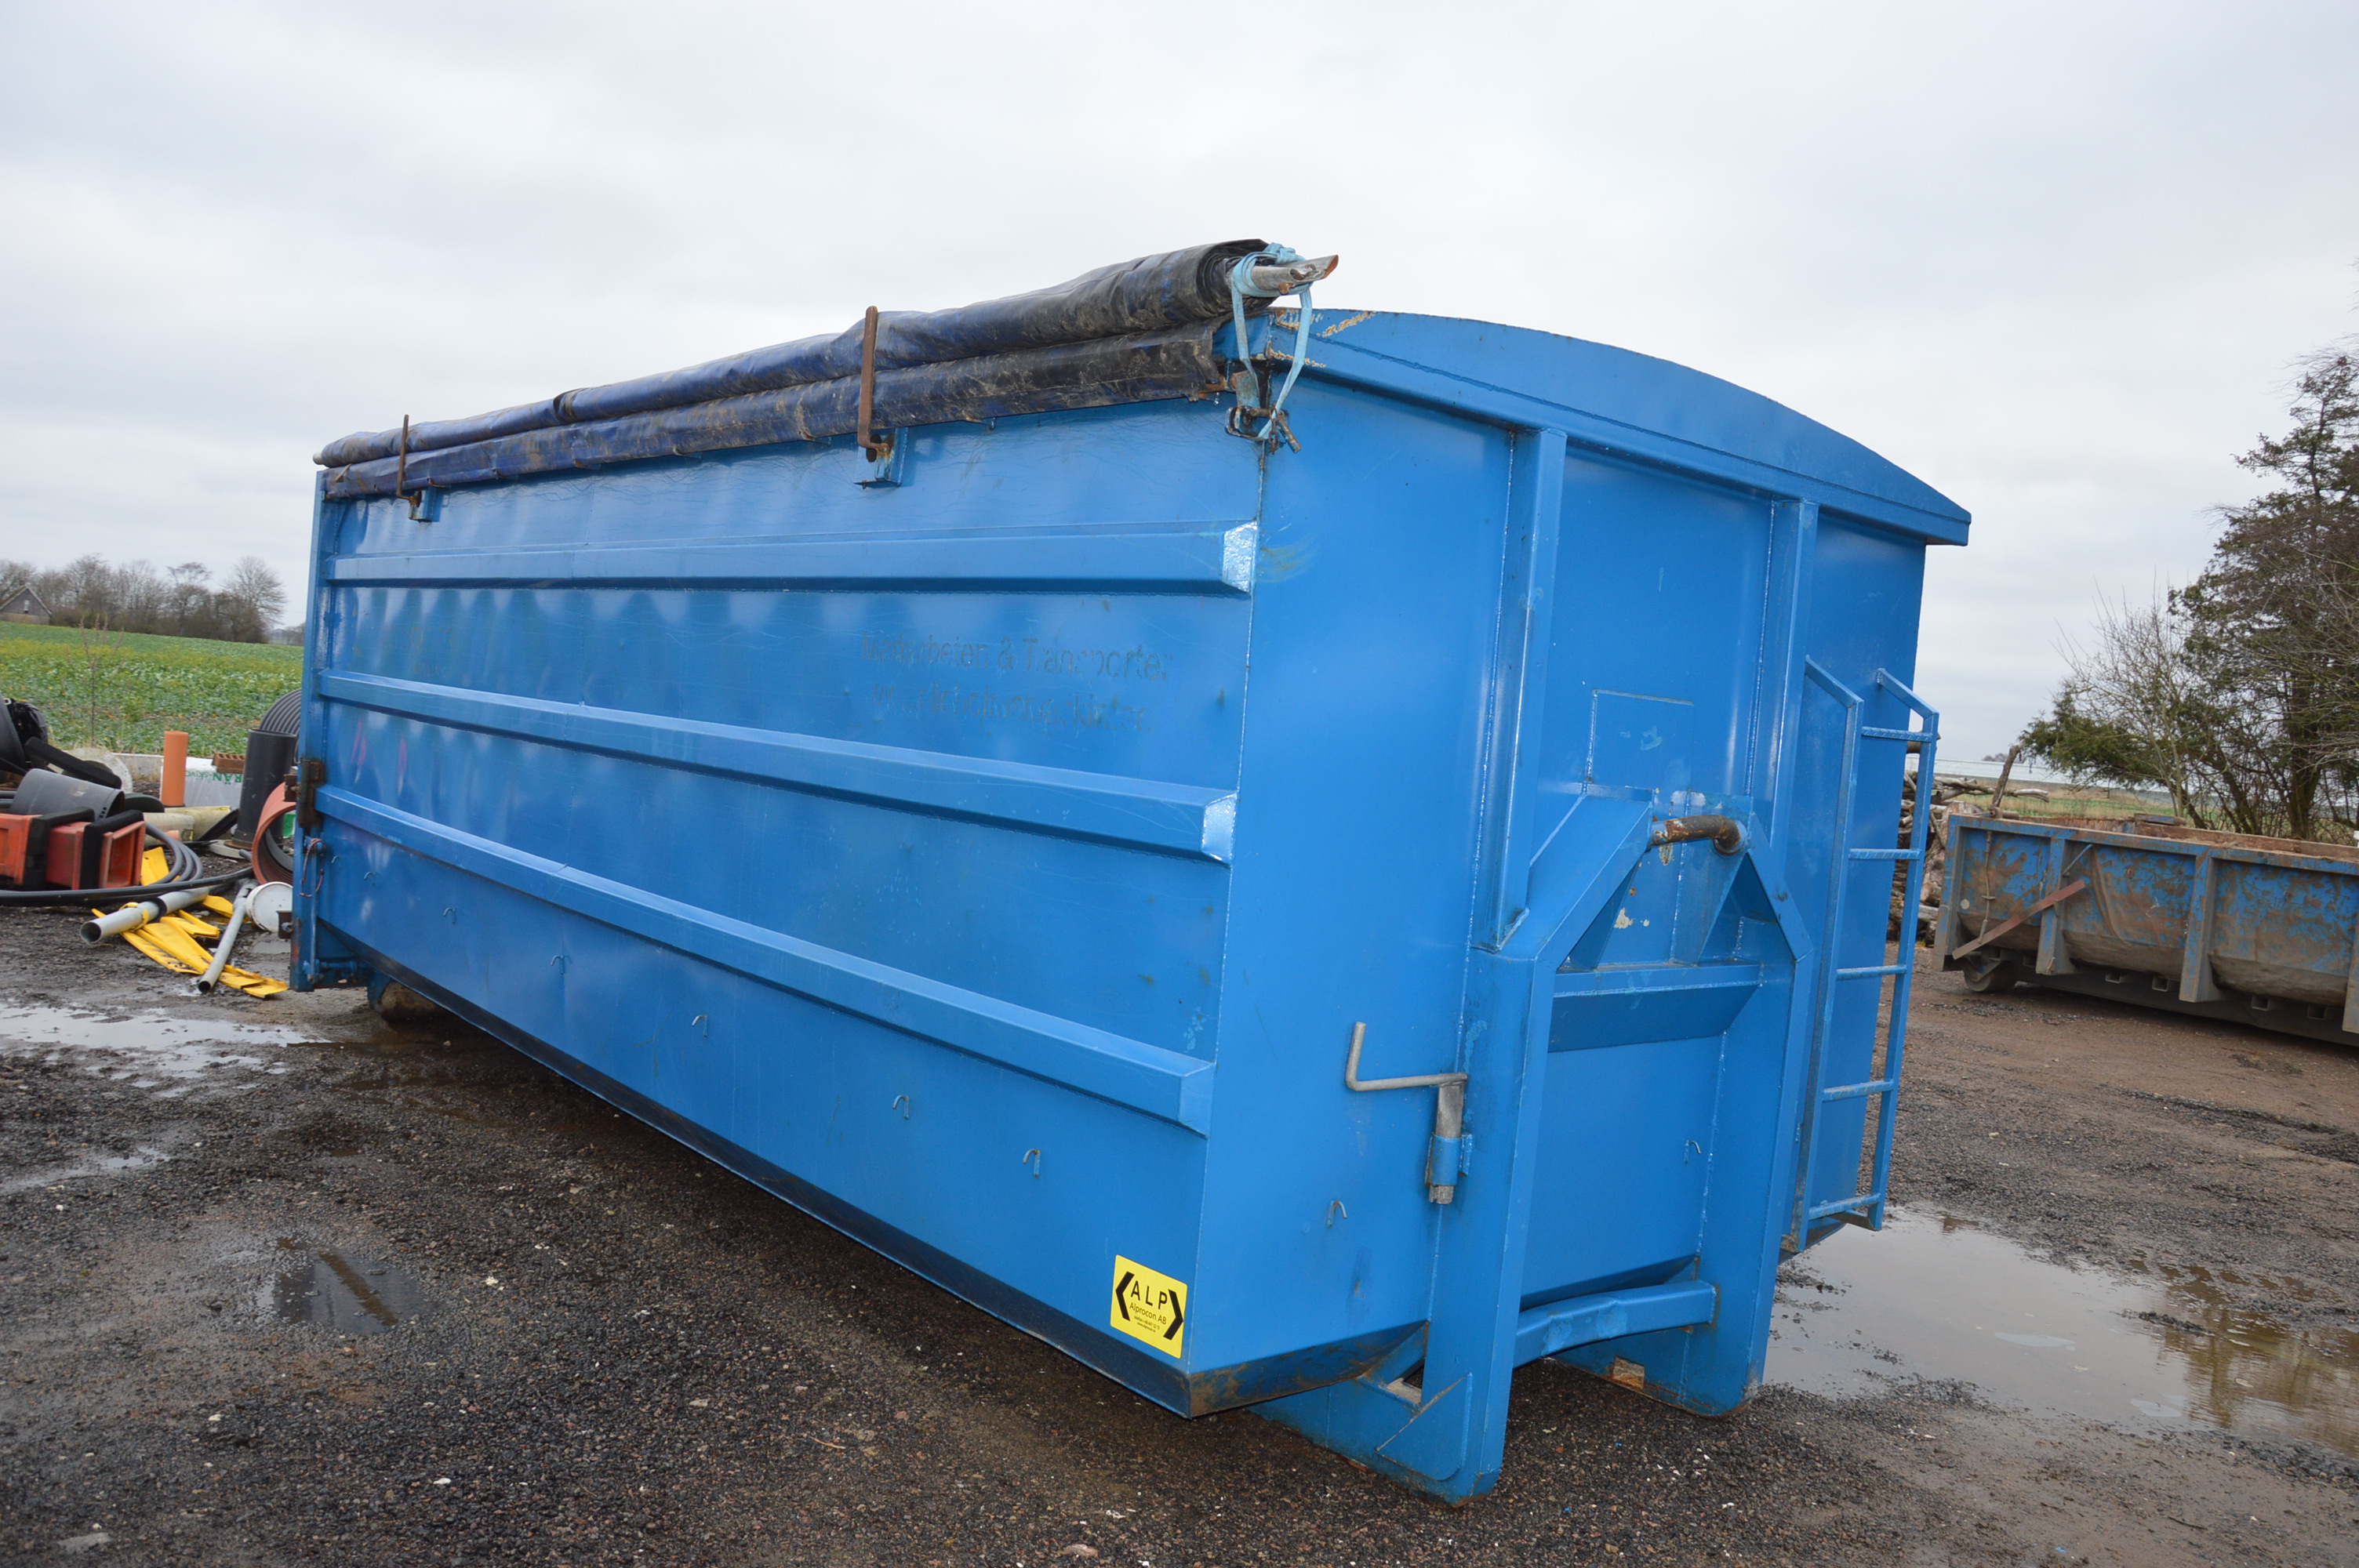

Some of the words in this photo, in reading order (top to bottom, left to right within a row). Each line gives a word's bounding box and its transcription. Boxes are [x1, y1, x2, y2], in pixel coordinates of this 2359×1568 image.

[997, 637, 1015, 670] &
[1130, 1280, 1168, 1309] ALP
[1129, 1302, 1157, 1319] Alprocon
[1158, 1315, 1167, 1325] AB
